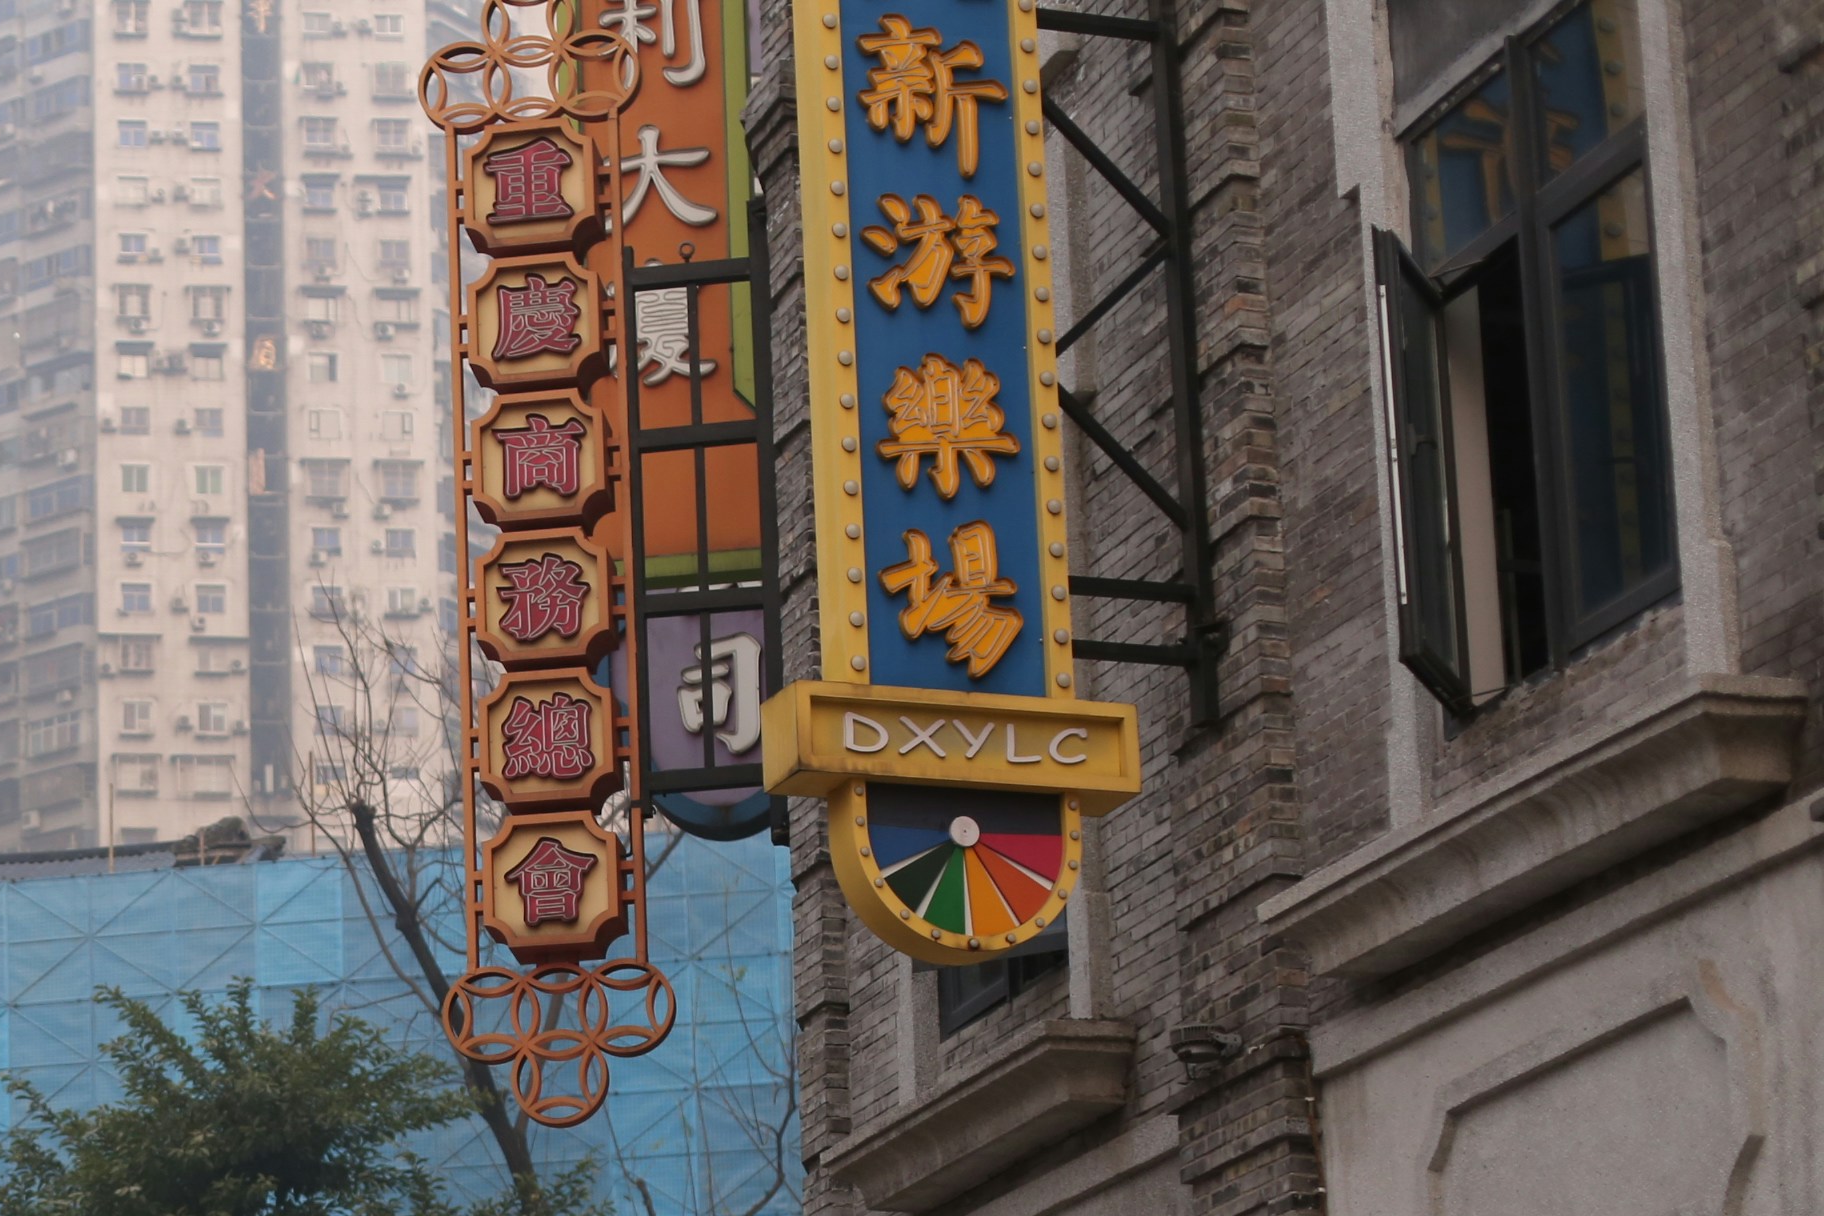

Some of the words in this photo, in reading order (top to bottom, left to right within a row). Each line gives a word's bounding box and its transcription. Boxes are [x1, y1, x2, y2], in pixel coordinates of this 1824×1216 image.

[483, 137, 599, 929] 重慶商務總會
[843, 711, 1088, 766] DXYLC
